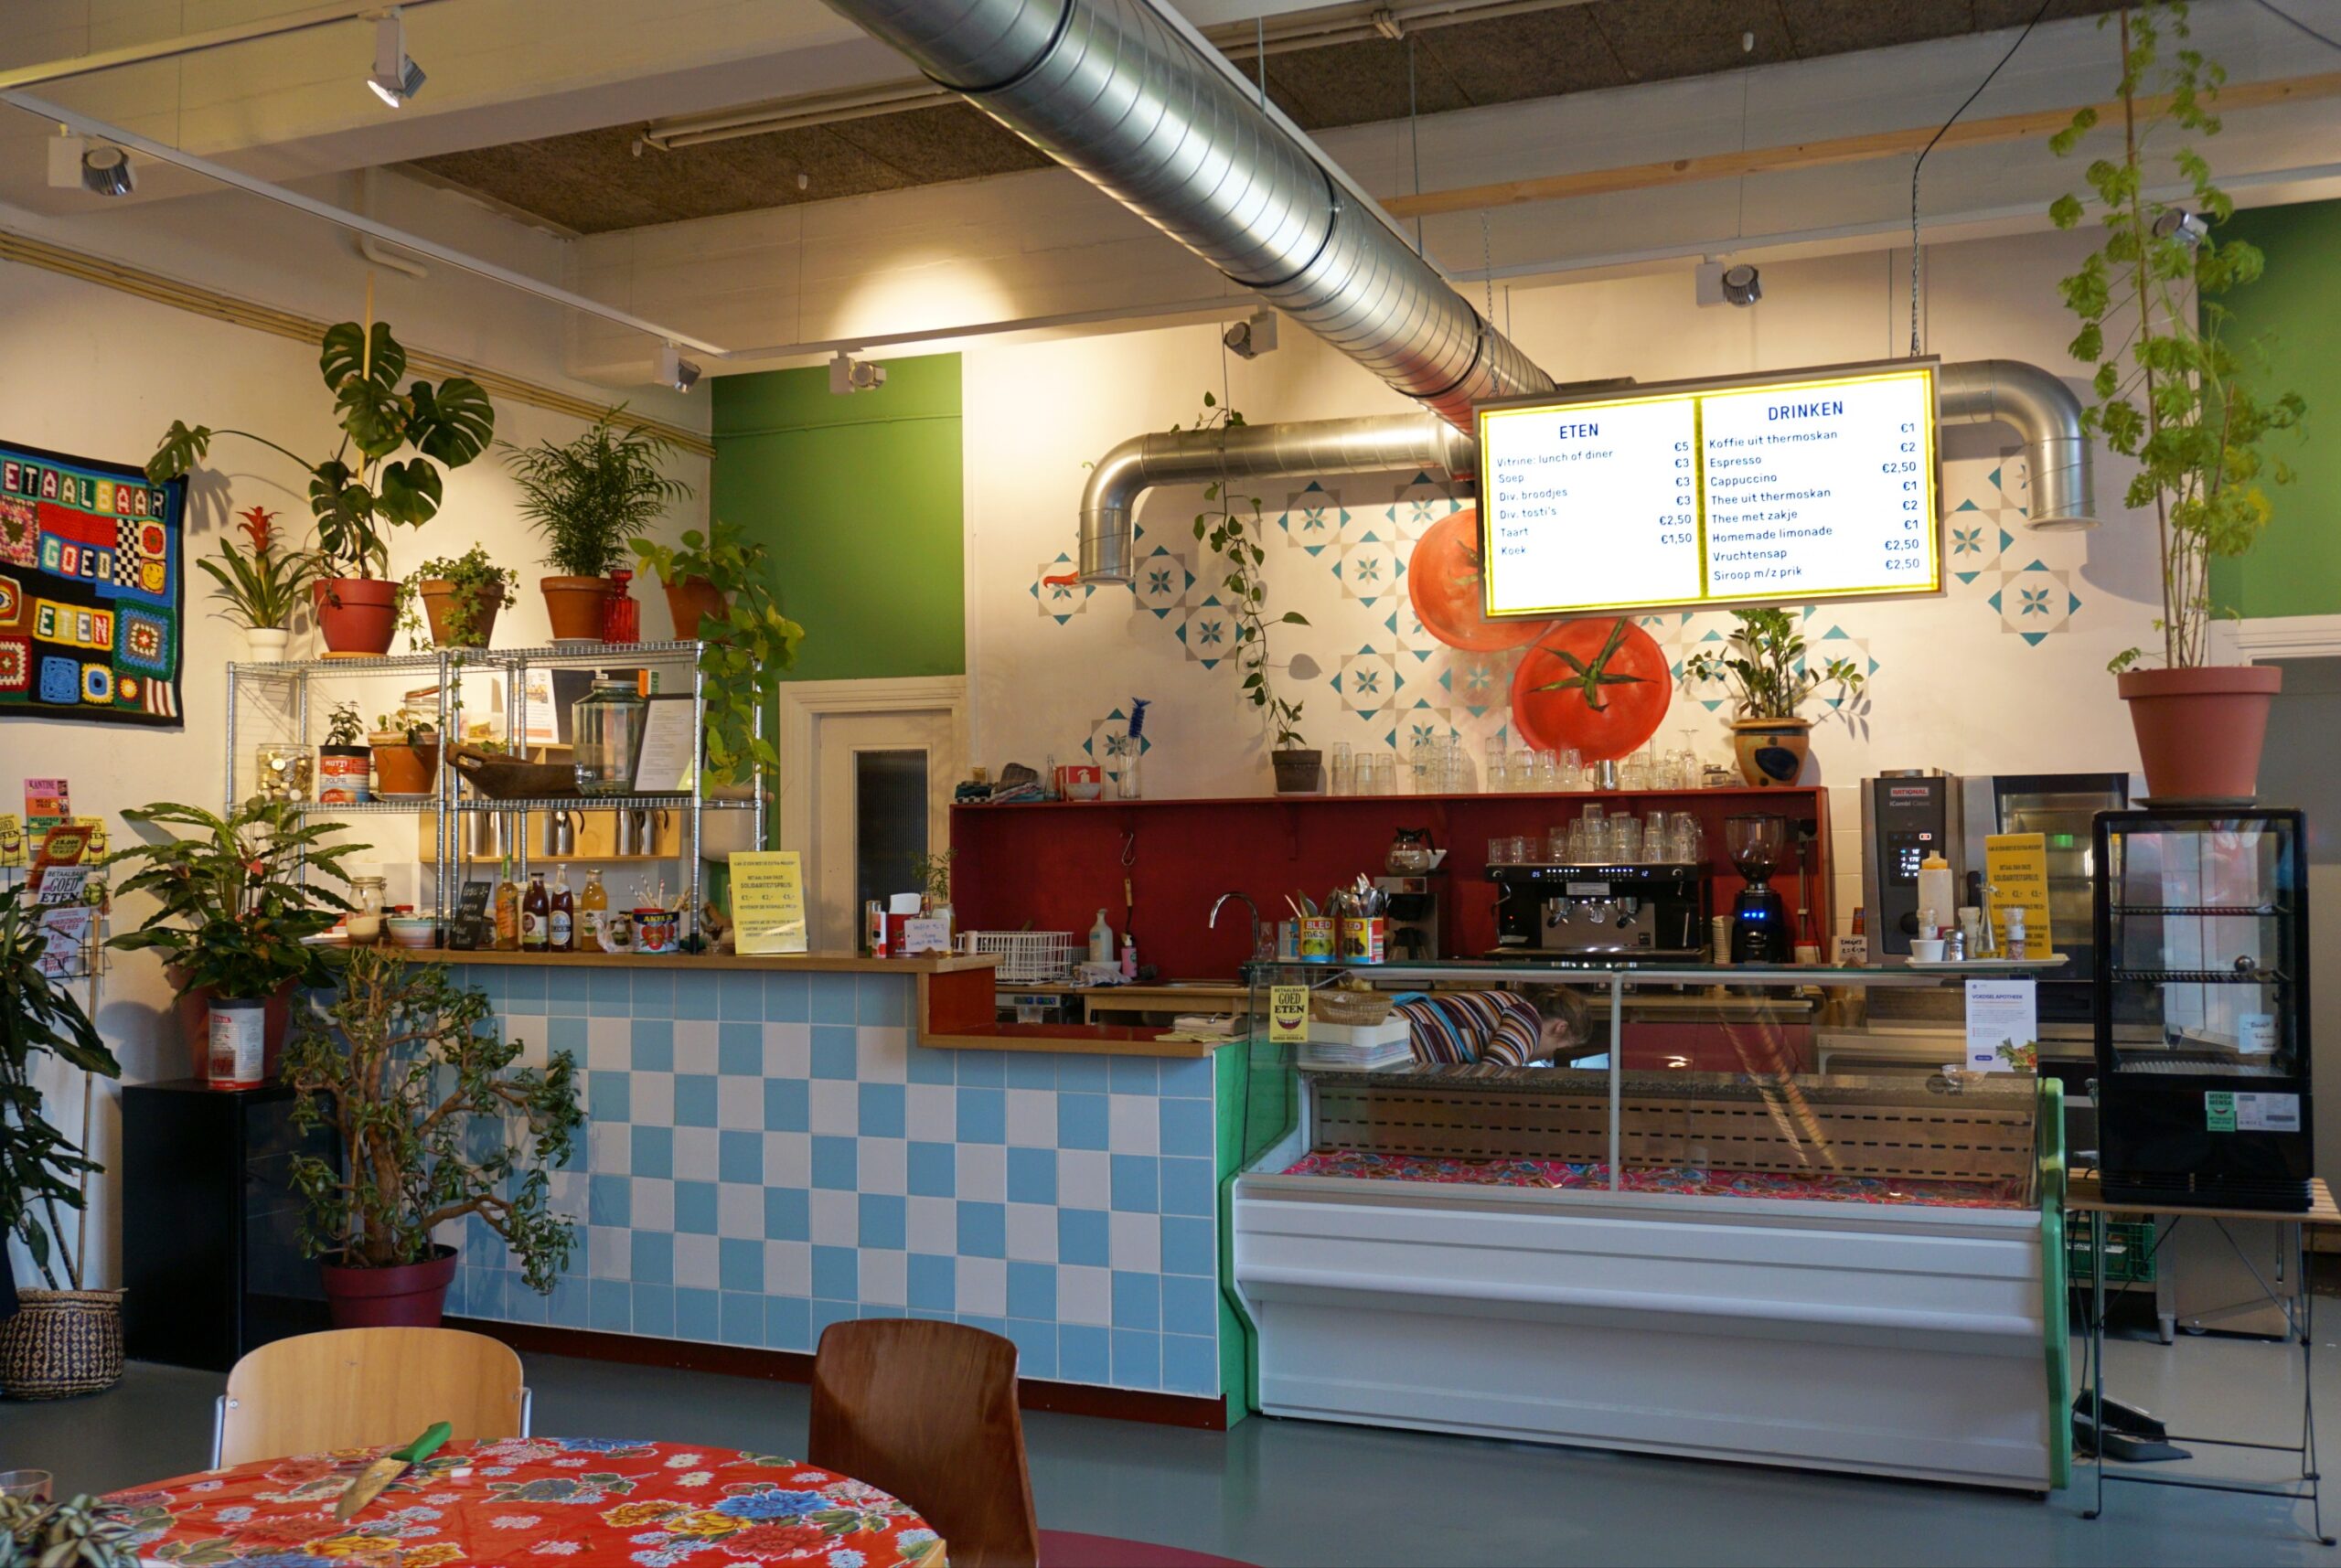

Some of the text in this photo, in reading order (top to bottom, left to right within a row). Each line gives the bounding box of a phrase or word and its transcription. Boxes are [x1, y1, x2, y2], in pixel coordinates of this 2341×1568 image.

[1768, 400, 1844, 421] DRINKEN
[1559, 423, 1599, 439] ETEN
[1709, 422, 1915, 449] Koffie uit thermoskan €1
[1497, 442, 1689, 467] Vitrine: lunch of diner €5
[1710, 443, 1916, 469] Espresso €2
[1498, 458, 1689, 485] Soep €3
[1711, 461, 1917, 487] Cappuccino €2,50
[1499, 476, 1690, 502] Div. broodjes €3
[1711, 480, 1918, 506] Thee uit thermoskan €1
[1500, 495, 1691, 520] Div. tosti's €3
[1712, 499, 1918, 524] Thee met zakje €2
[1501, 514, 1692, 539] Taart €2,50
[1713, 519, 1919, 543] Homemade limonade €1
[1501, 533, 1692, 556] Koek €1,50
[1713, 539, 1919, 562] Vruchtensap €2,50
[45, 536, 112, 580] GOED
[1714, 559, 1919, 581] Siroop m/z prik €2,50
[38, 605, 110, 645] ETEN
[50, 878, 79, 891] GOED
[1306, 921, 1331, 930] BLED
[1274, 1005, 1305, 1013] ETEN
[1278, 993, 1300, 1004] GOED
